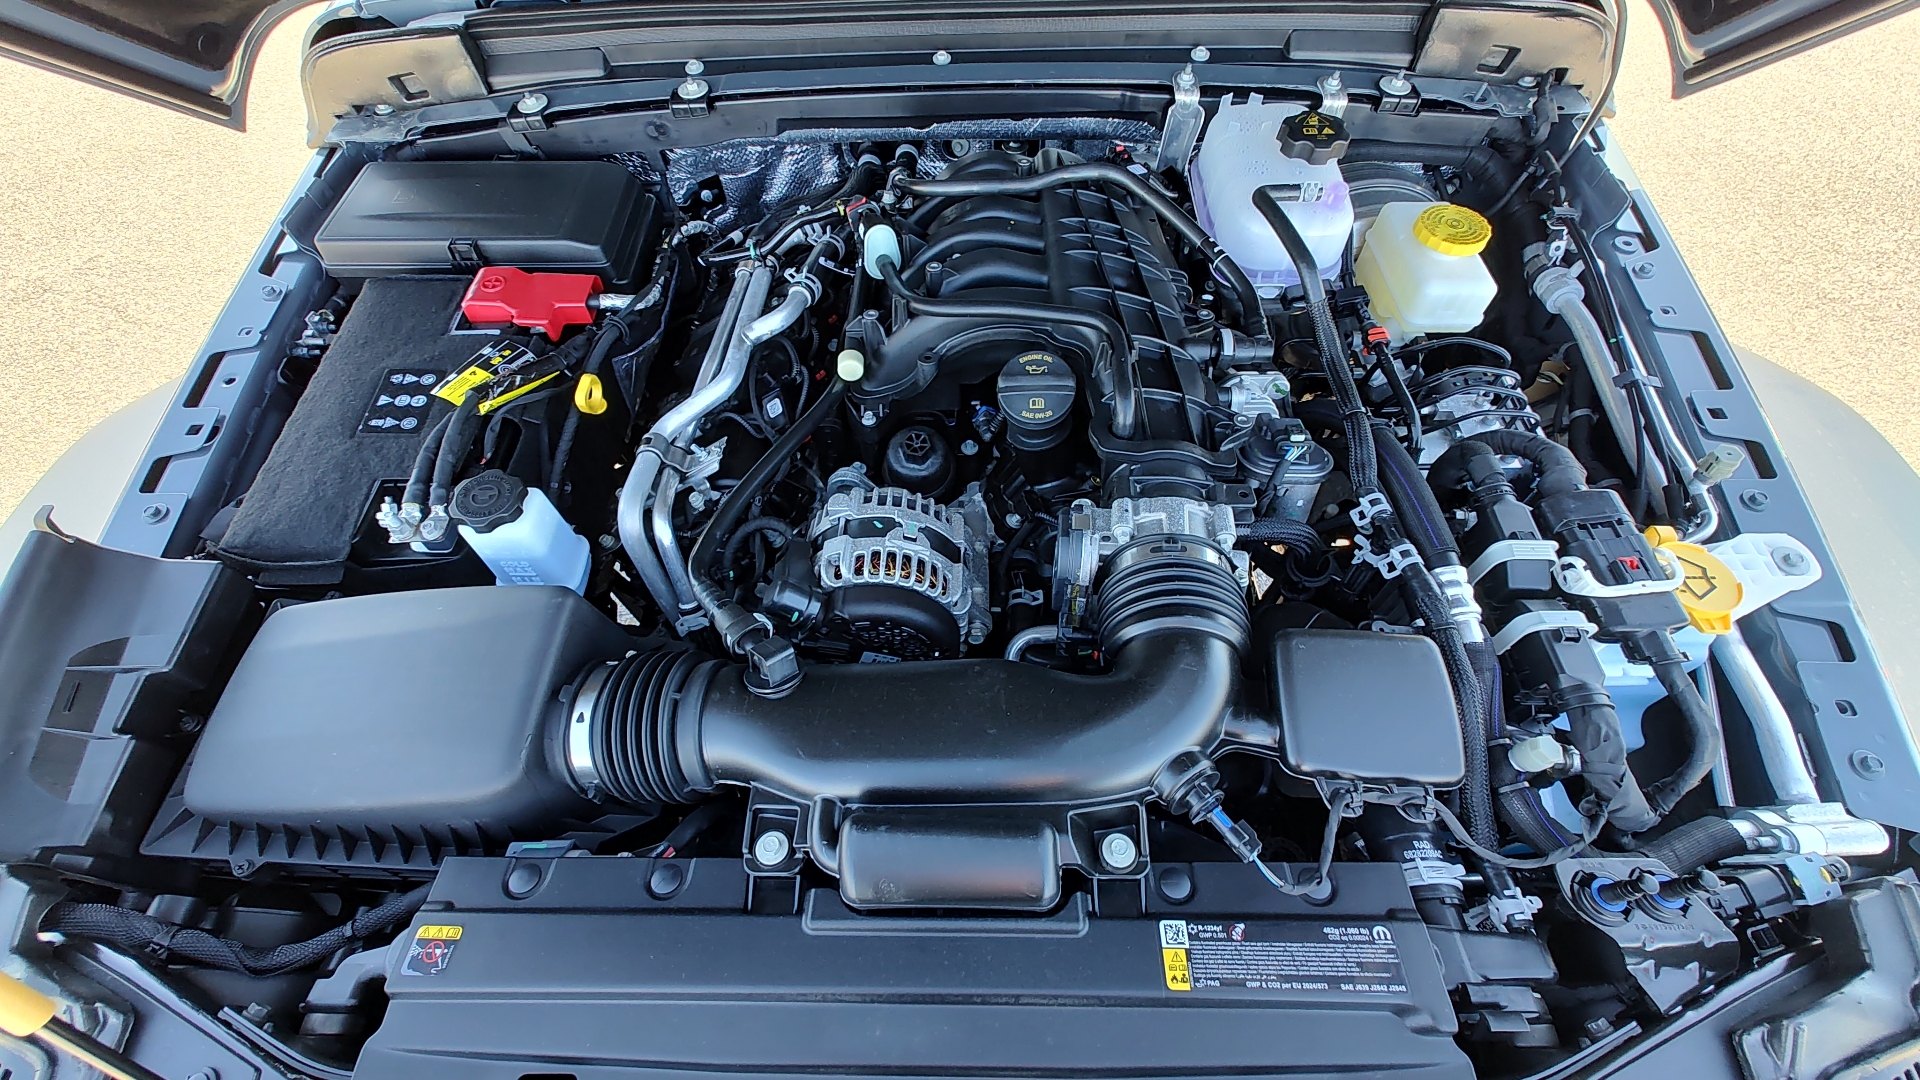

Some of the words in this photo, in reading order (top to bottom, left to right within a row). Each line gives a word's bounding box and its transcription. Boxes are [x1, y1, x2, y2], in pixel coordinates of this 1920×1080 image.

[1019, 354, 1042, 363] ENGINE
[1043, 354, 1053, 363] OIL
[1021, 410, 1033, 418] SAE
[1034, 410, 1053, 419] 0W-20
[1412, 840, 1430, 849] RAD
